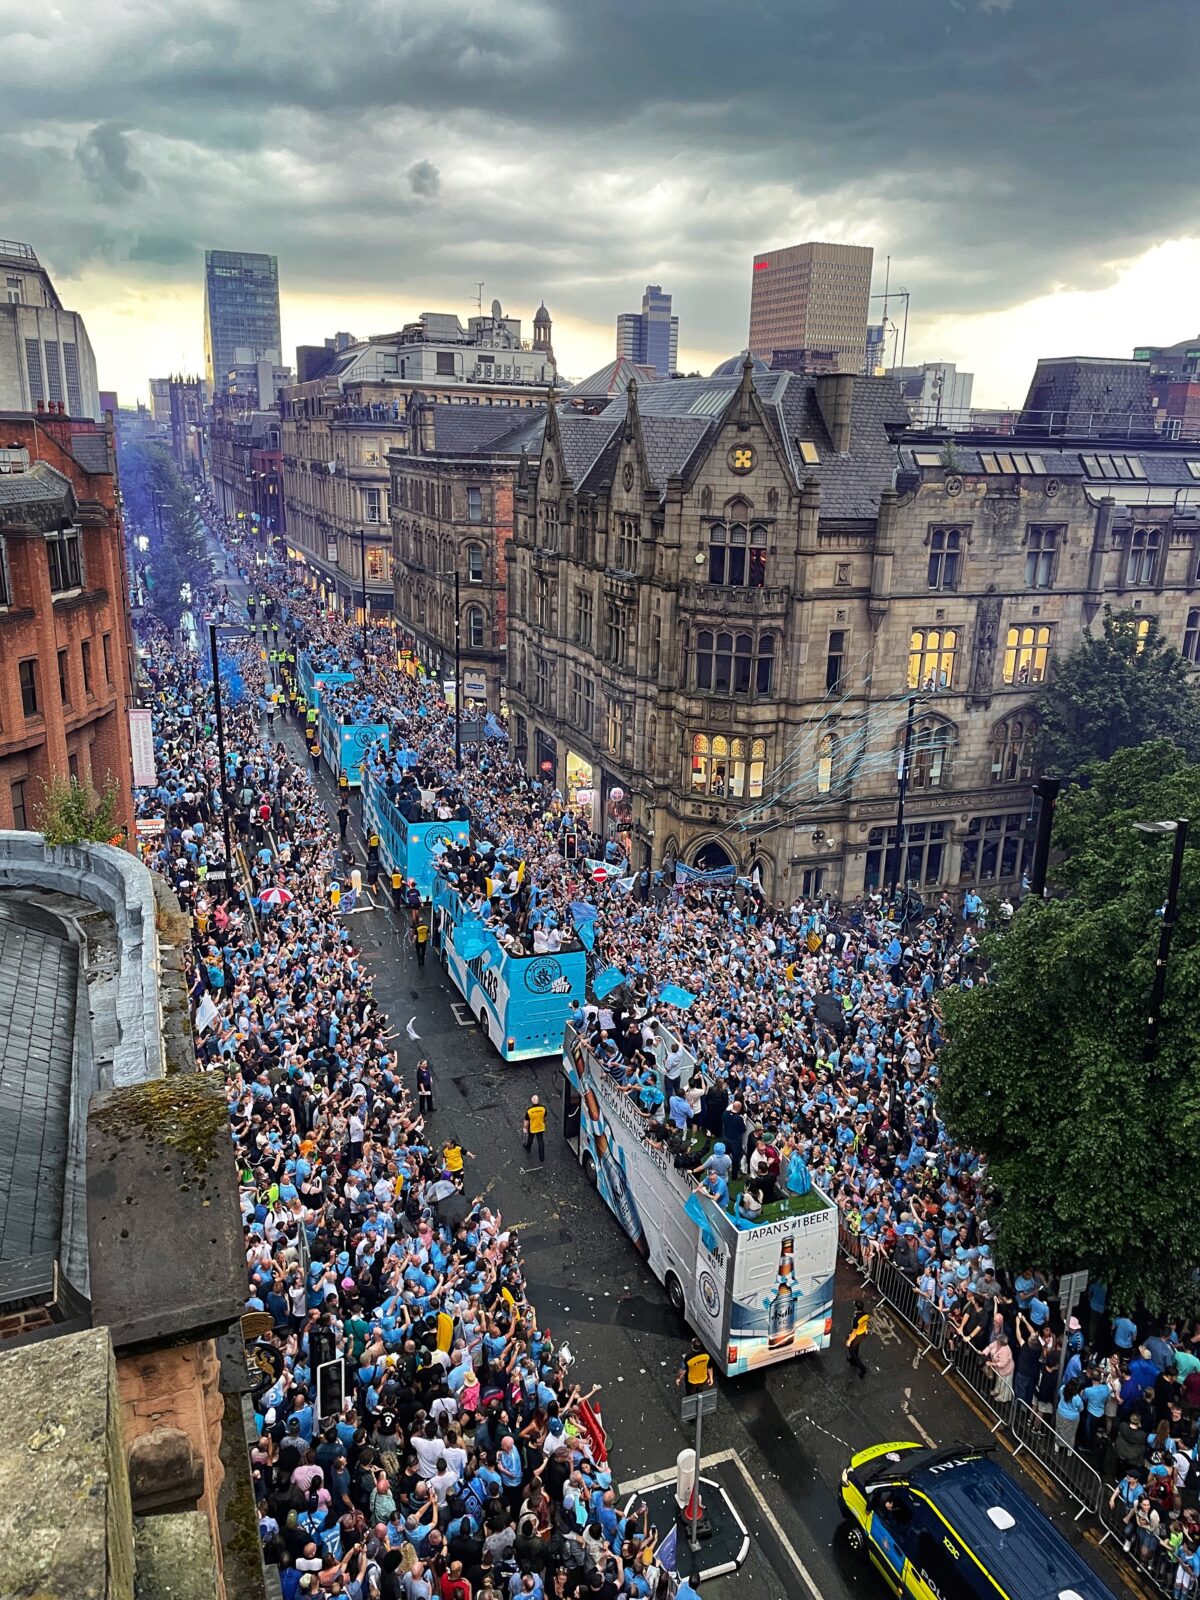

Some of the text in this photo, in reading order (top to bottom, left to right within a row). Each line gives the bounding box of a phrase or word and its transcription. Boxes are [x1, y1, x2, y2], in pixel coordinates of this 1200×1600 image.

[649, 1149, 667, 1175] BEER
[746, 1211, 829, 1242] JAPAN'S #1 BEER
[384, 1416, 392, 1427] 9
[928, 1459, 968, 1474] TAU
